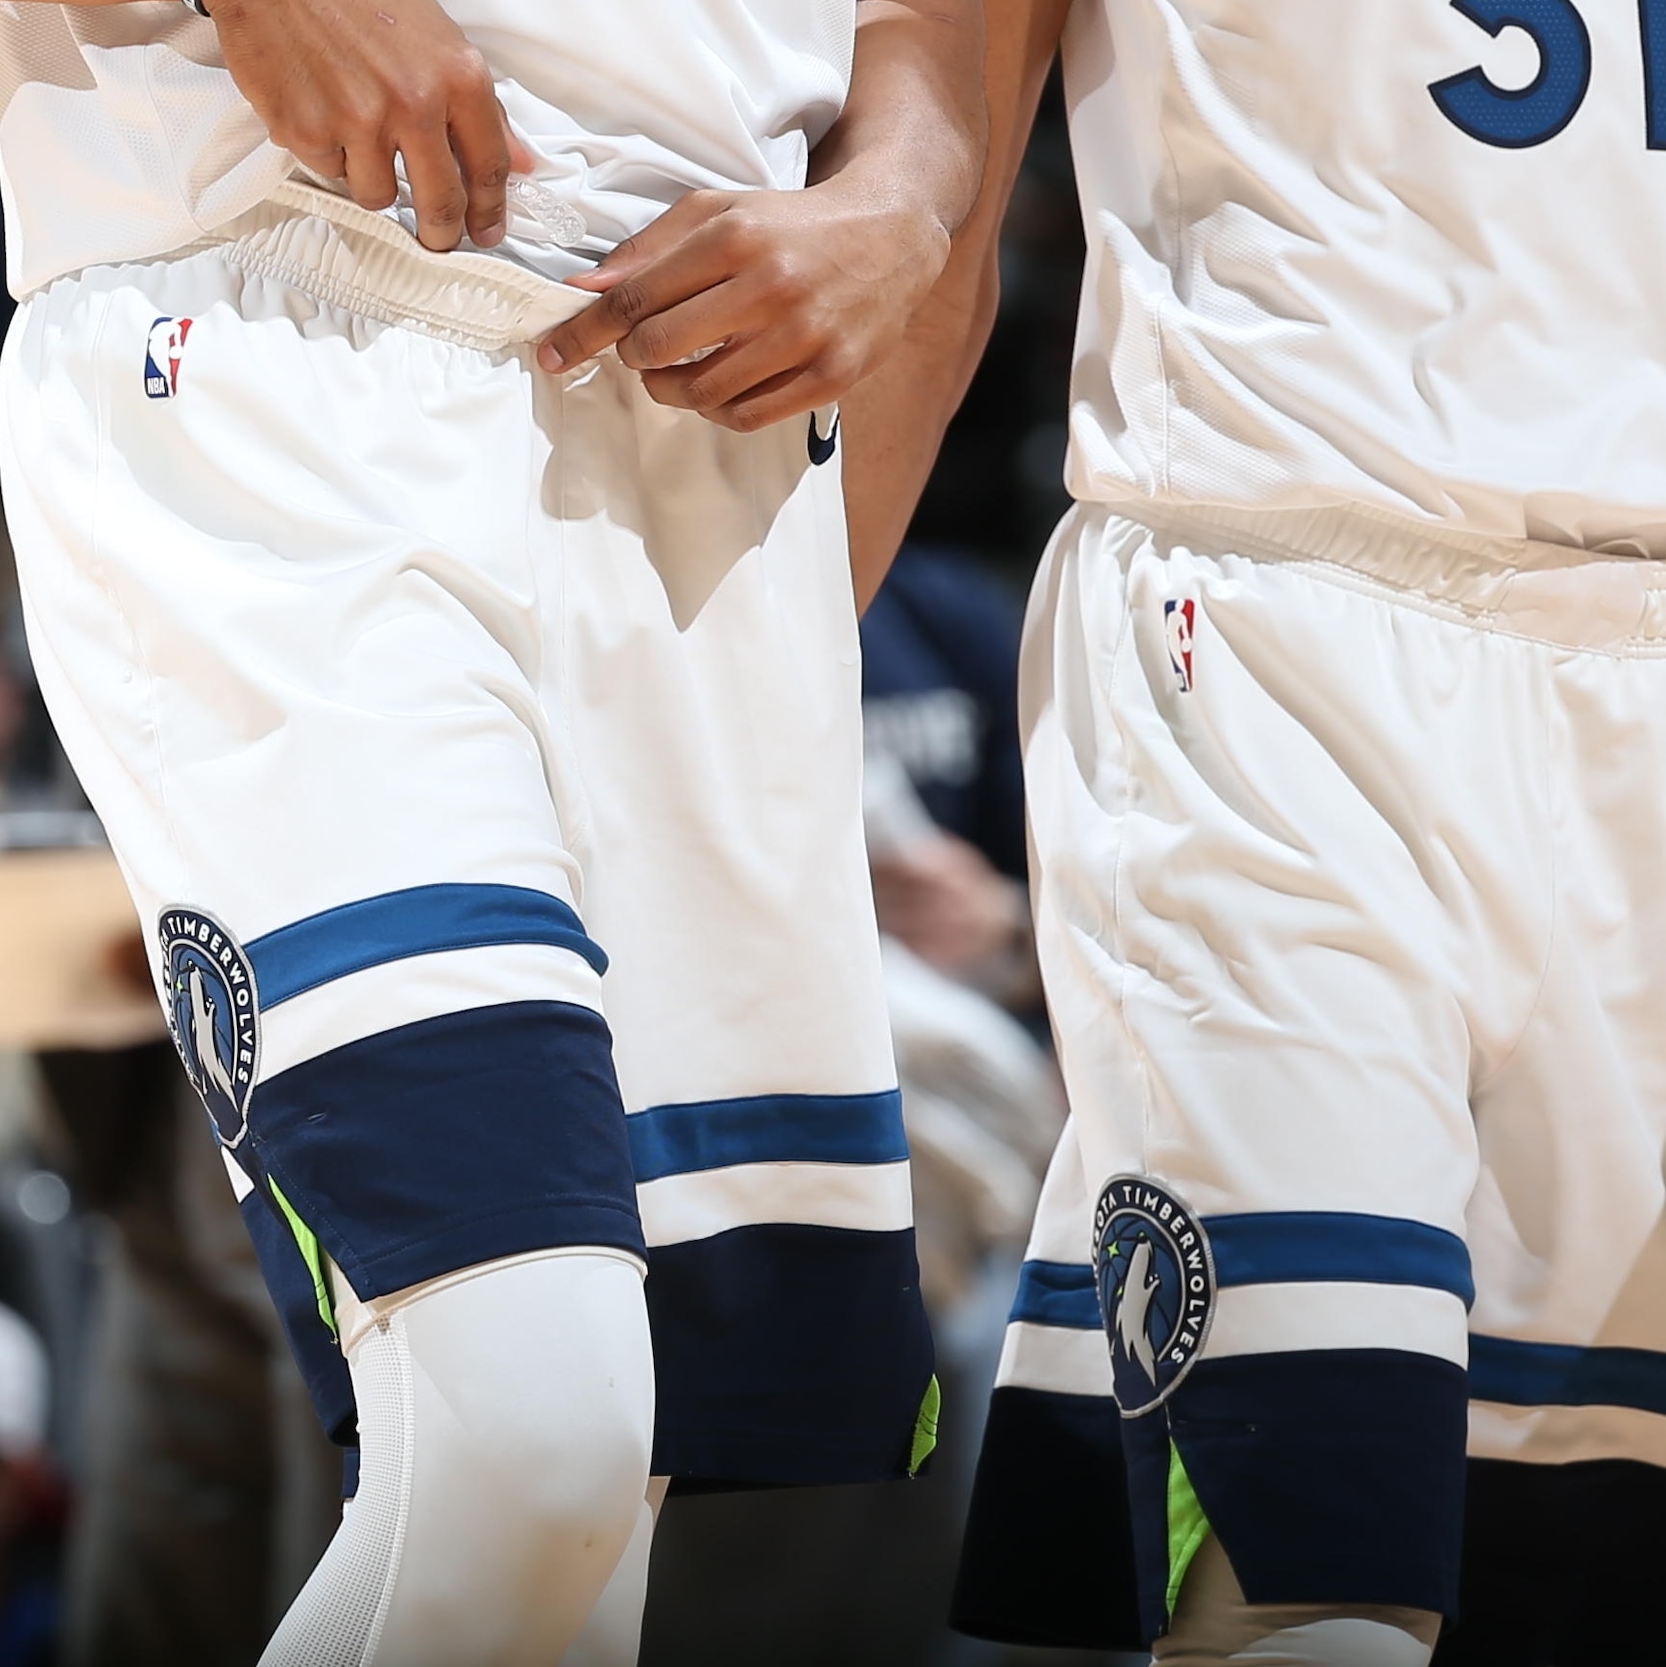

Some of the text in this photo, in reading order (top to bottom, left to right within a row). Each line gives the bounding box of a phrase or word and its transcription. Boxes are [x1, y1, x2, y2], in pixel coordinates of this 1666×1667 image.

[147, 377, 166, 394] NBA
[167, 916, 255, 1084] TIMBERWOLVES
[1122, 1185, 1206, 1364] TIMBERWOLVES
